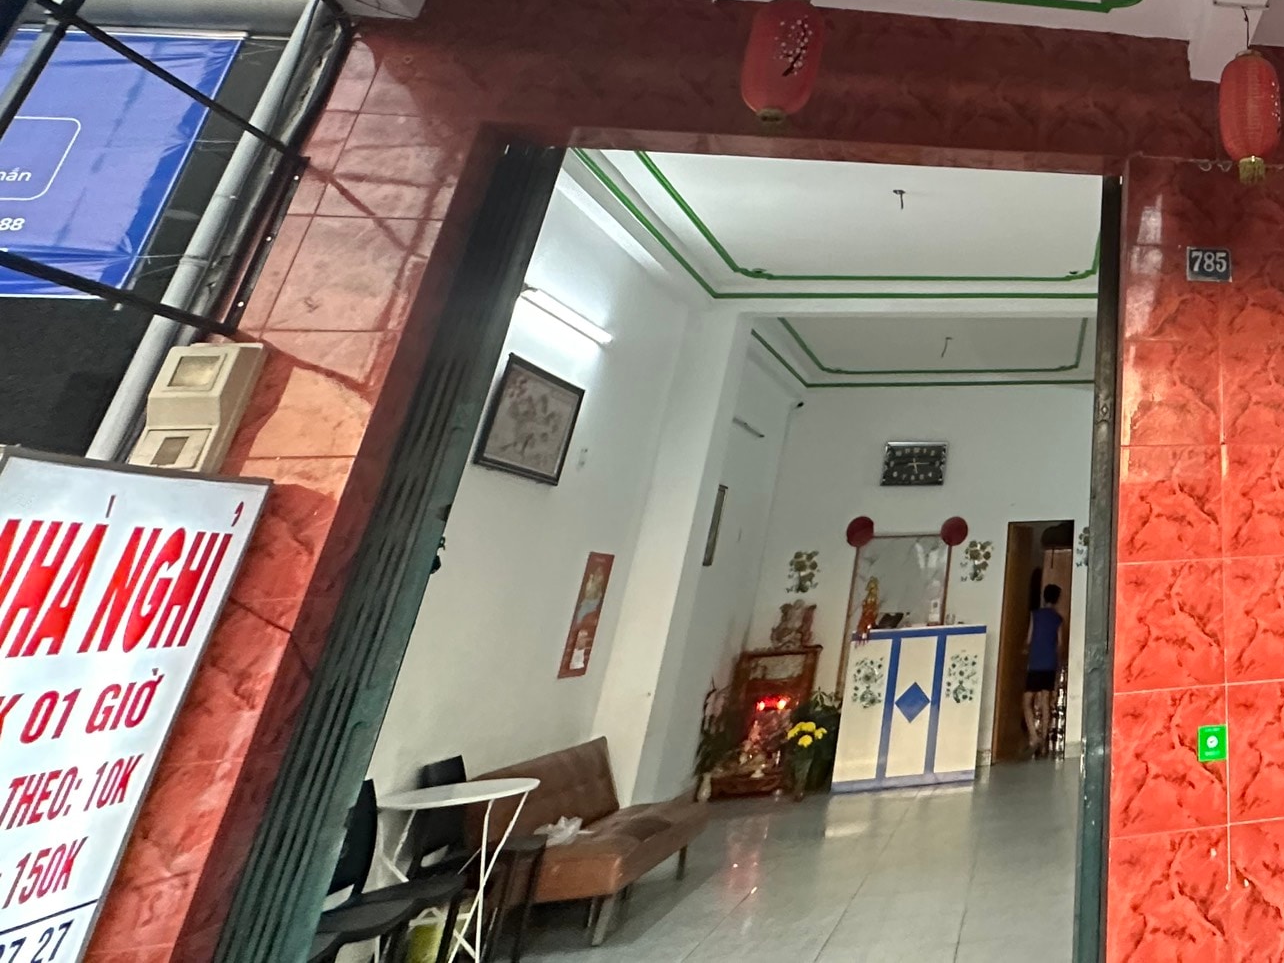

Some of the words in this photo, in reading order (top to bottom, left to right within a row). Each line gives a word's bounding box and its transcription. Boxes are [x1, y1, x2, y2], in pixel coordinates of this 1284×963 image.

[1190, 250, 1228, 273] 785
[77, 501, 245, 654] NGHỈ
[20, 688, 82, 744] 01
[85, 667, 165, 734] GIỜ
[83, 753, 144, 812] 10K
[1, 835, 89, 910] 150K
